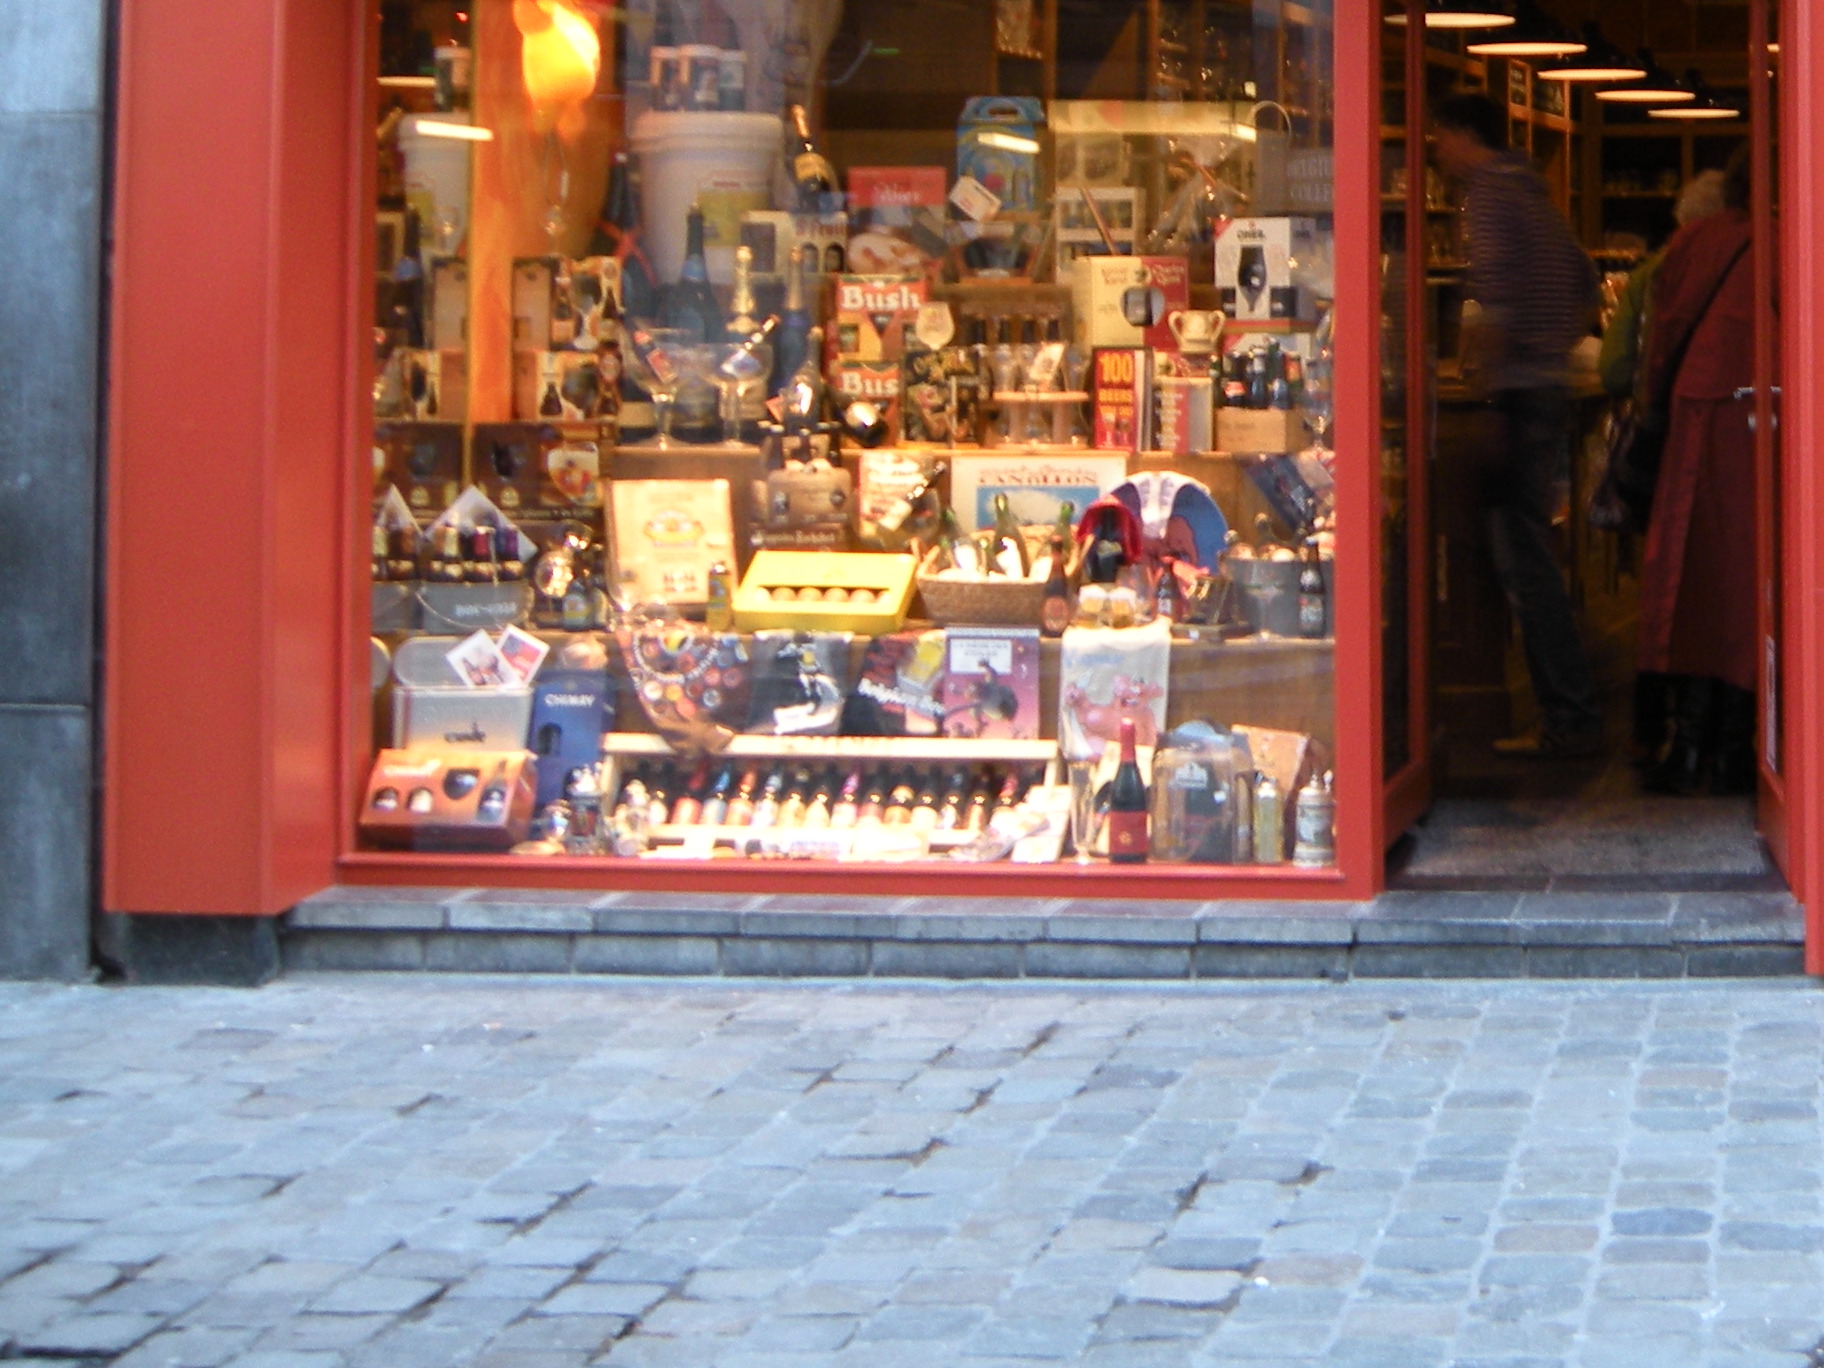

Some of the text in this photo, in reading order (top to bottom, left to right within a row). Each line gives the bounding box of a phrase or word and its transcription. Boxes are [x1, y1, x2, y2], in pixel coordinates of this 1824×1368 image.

[842, 285, 921, 311] Bush
[1099, 352, 1133, 383] 100
[841, 371, 899, 396] Bus
[544, 693, 595, 708] CHIMAY
